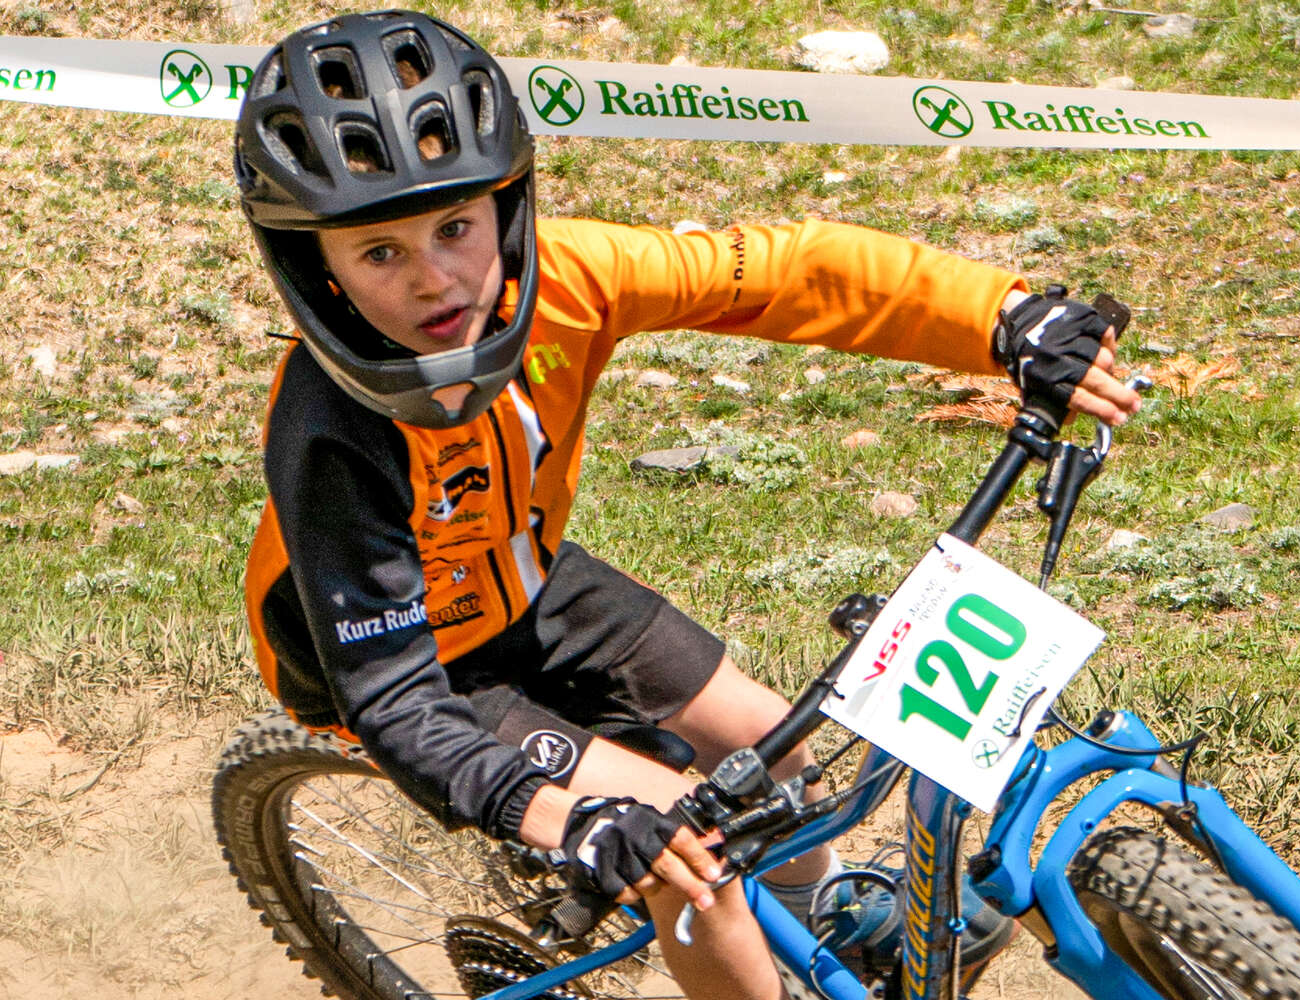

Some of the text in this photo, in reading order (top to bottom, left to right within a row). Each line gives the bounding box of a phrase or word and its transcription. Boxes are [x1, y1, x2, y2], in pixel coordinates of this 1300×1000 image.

[594, 79, 810, 122] Raiffeisen
[981, 100, 1212, 138] Raiffeisen
[335, 616, 385, 644] Kurz
[863, 618, 912, 683] VSS
[899, 593, 1027, 742] 120
[992, 643, 1062, 736] Raiffeisen
